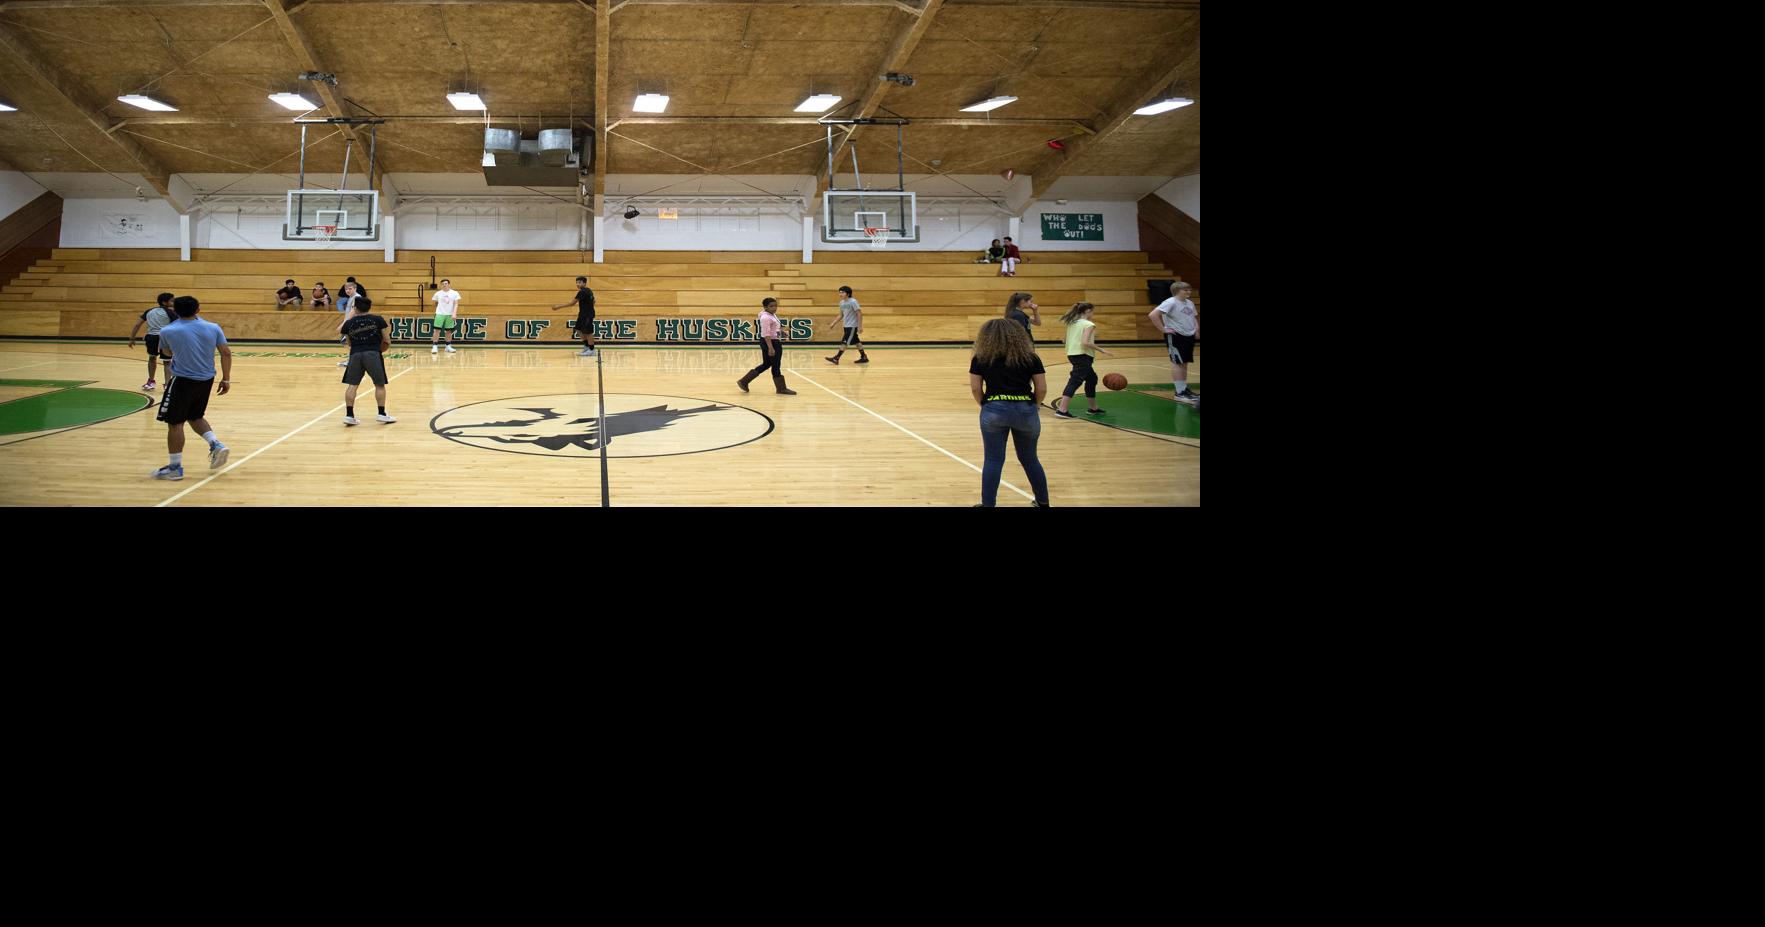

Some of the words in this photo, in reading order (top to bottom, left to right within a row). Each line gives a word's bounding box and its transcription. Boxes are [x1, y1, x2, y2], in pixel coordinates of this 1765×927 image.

[1078, 214, 1094, 222] LET
[1049, 222, 1067, 230] THE
[506, 320, 550, 339] OF
